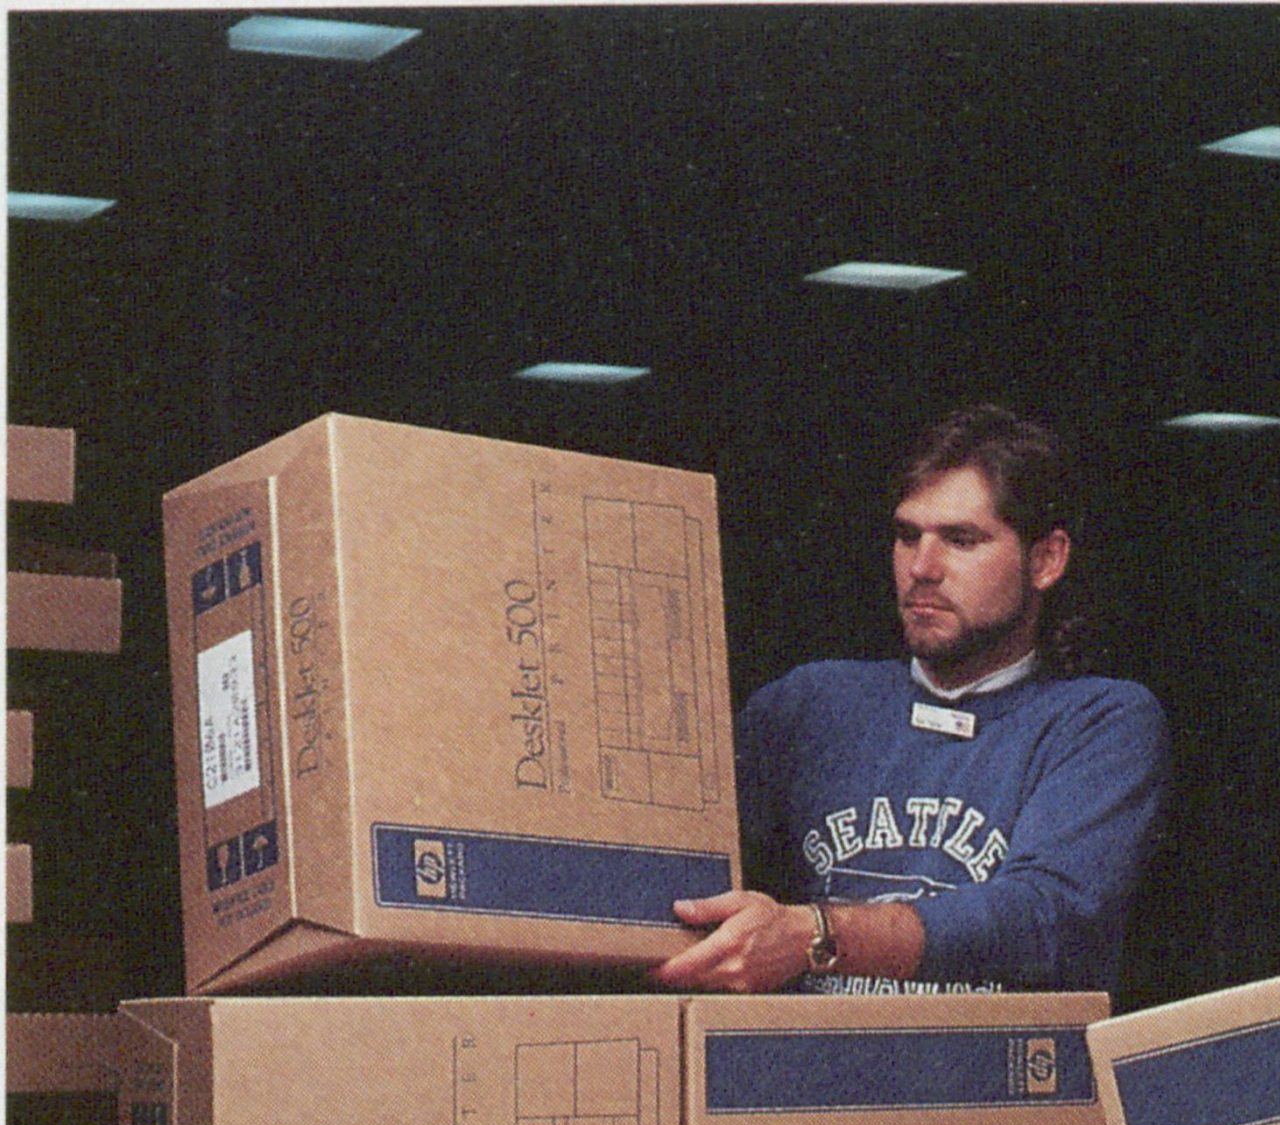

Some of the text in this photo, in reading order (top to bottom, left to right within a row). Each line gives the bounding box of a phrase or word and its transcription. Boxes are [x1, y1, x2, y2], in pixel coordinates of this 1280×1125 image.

[504, 580, 548, 789] DeskJet 500
[802, 795, 1009, 883] SEATTLE
